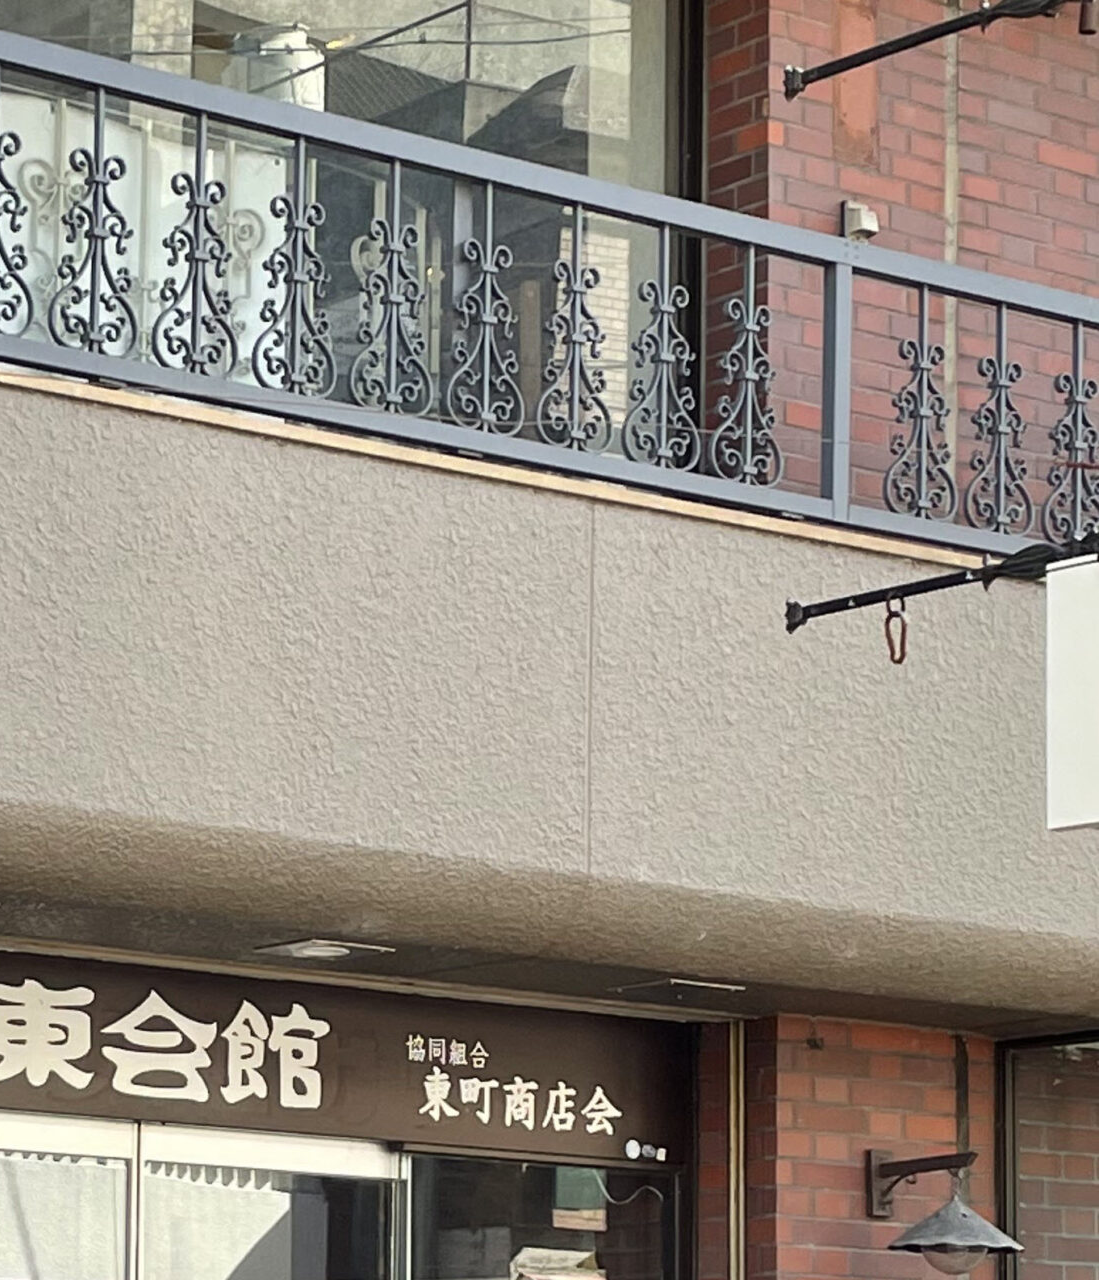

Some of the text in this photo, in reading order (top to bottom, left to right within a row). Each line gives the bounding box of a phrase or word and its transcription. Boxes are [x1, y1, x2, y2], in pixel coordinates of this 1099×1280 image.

[405, 1033, 490, 1069] 協同組合
[418, 1065, 623, 1136] 東町商店会
